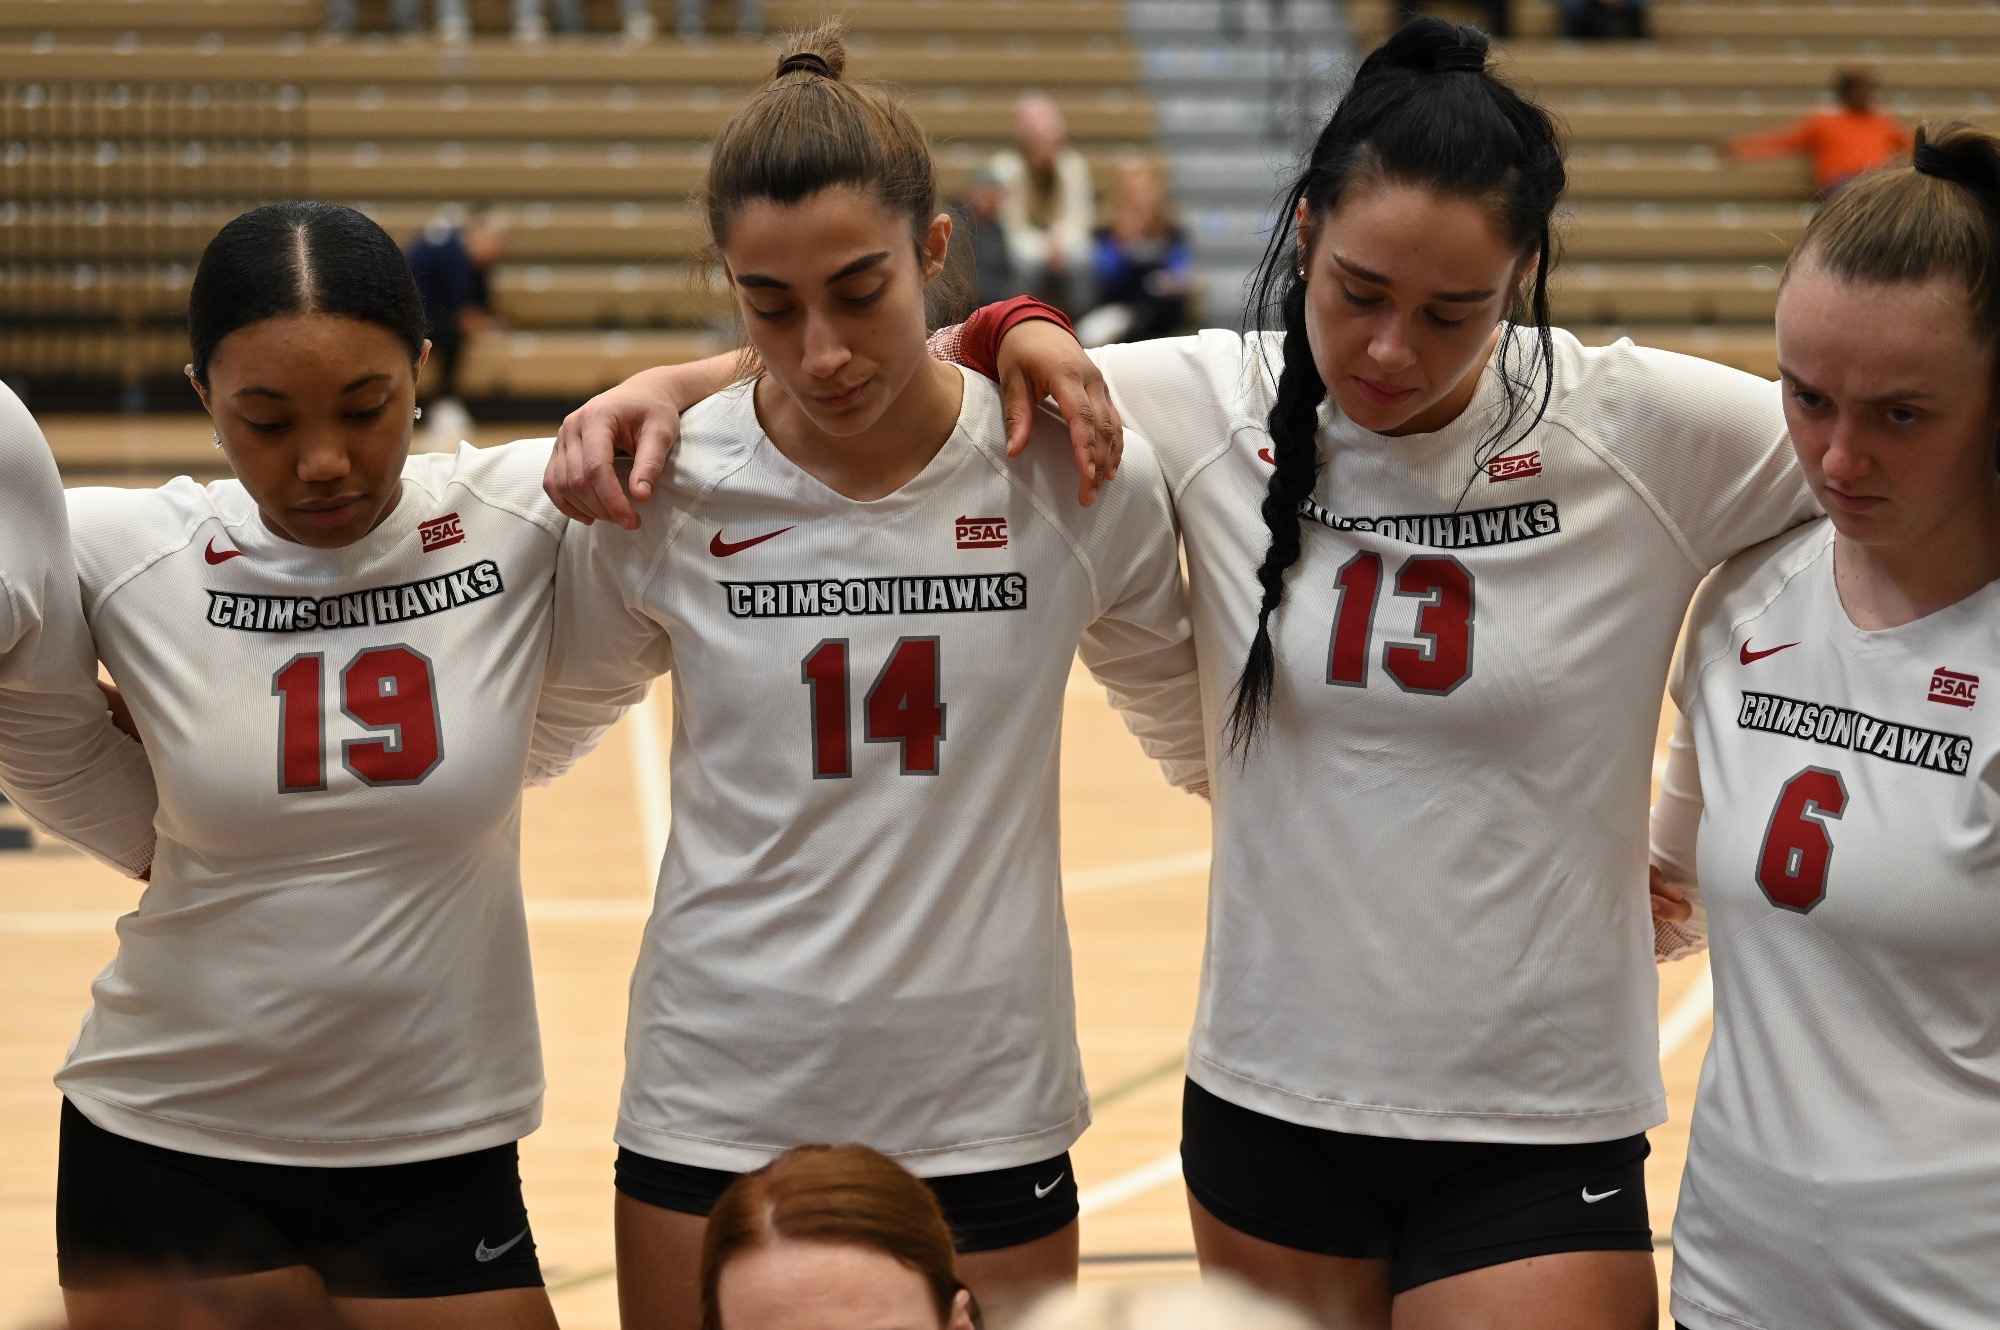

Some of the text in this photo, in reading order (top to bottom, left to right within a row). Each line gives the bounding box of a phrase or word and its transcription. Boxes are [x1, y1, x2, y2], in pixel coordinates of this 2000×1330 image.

[1488, 454, 1542, 476] PSAC
[420, 518, 464, 545] PSAC
[955, 524, 1008, 541] PSAC
[1430, 501, 1562, 548] HAWKS
[208, 560, 505, 631] CRIMSON HAWKS
[722, 573, 1027, 617] CRIMSON HAWKS
[1326, 549, 1476, 697] 13
[800, 635, 947, 779] 14
[1929, 676, 1979, 700] PSAC
[271, 642, 445, 794] 19
[1738, 691, 1973, 777] CRIMSON HAWKS
[1755, 765, 1850, 915] 6
